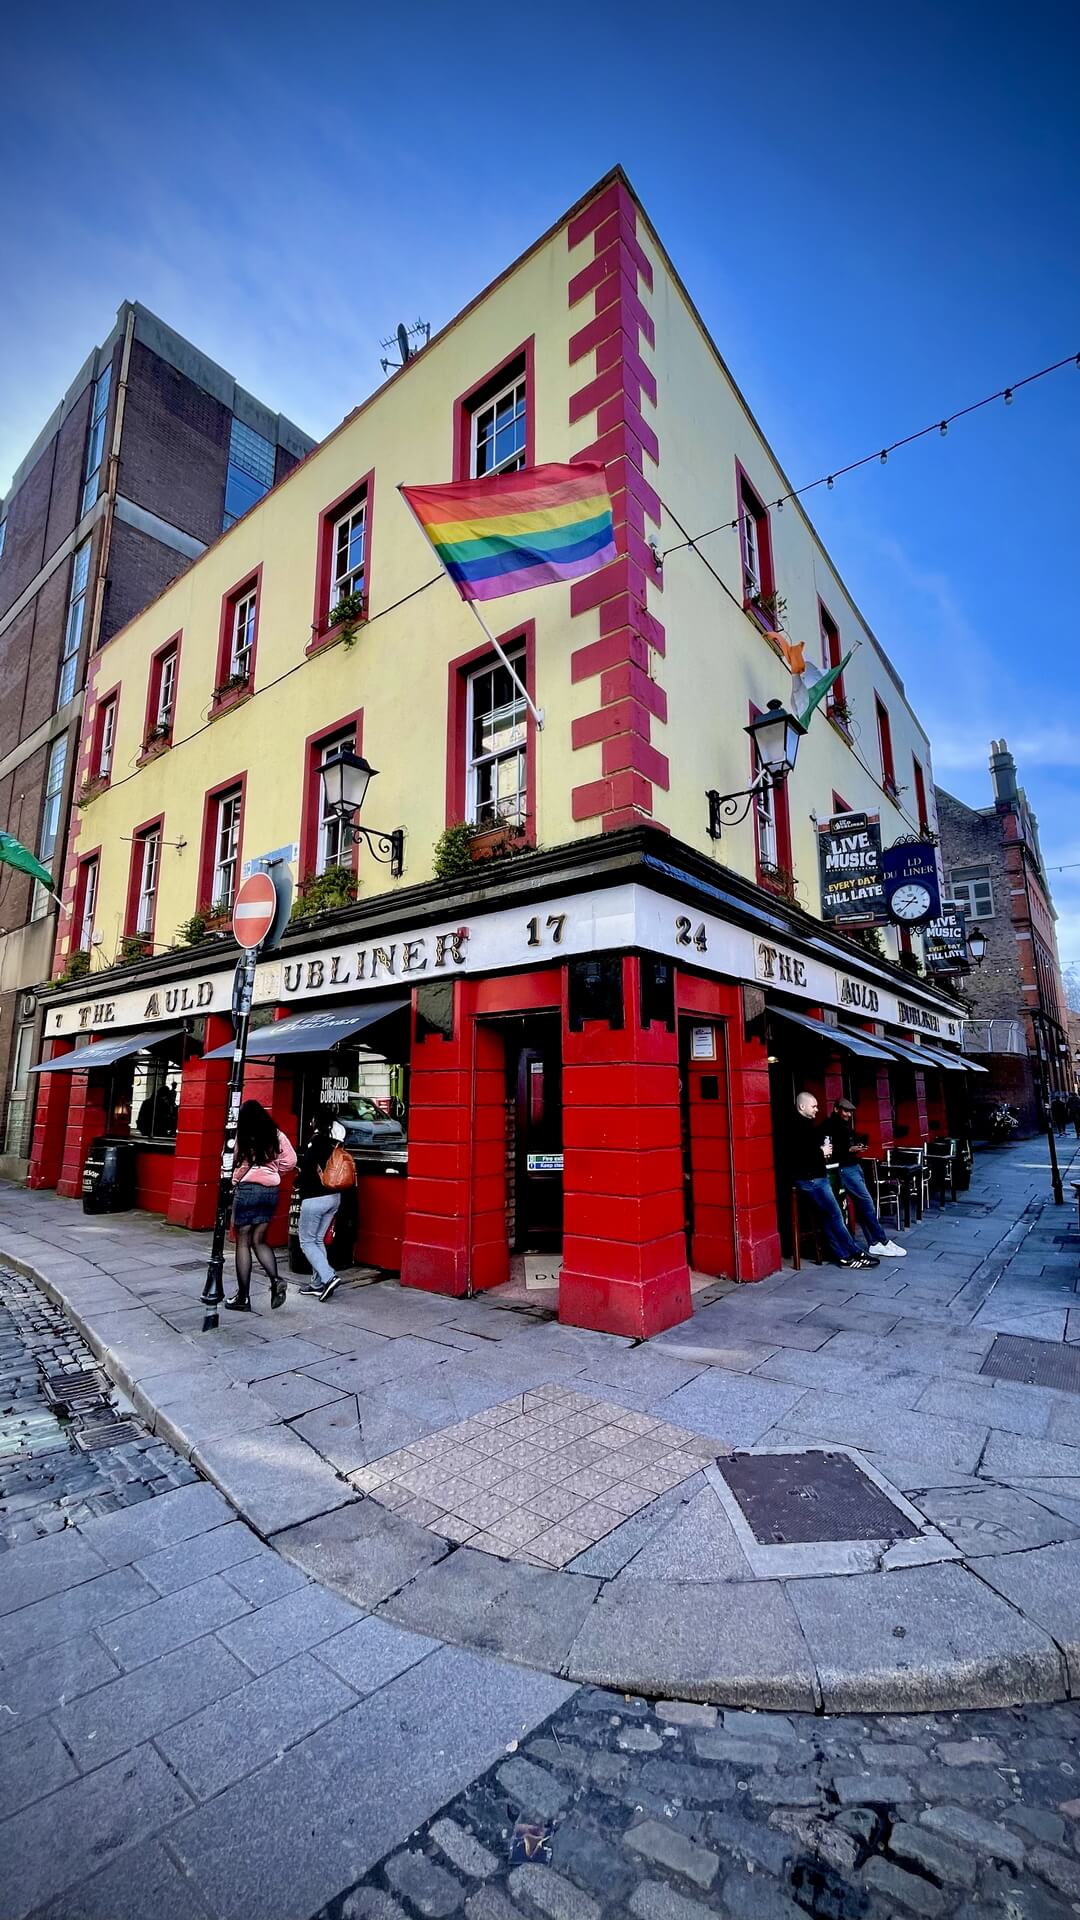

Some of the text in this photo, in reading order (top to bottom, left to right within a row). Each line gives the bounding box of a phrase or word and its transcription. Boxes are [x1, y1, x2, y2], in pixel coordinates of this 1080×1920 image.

[830, 832, 870, 854] LIVE
[825, 851, 877, 869] MUSIC
[903, 865, 934, 877] LINER
[828, 875, 877, 892] EVERY DAY
[824, 885, 883, 906] TILL LATE
[526, 912, 567, 947] 17
[929, 915, 957, 928] LIVE
[675, 915, 708, 953] 24
[926, 927, 962, 938] MUSIC
[926, 950, 965, 961] TILL LATE
[758, 942, 807, 988] THE
[841, 977, 879, 1012] AULD
[78, 1002, 116, 1028] THE
[144, 981, 213, 1017] AULD
[321, 1076, 349, 1090] THE AULD
[320, 1090, 349, 1103] DUBLINER
